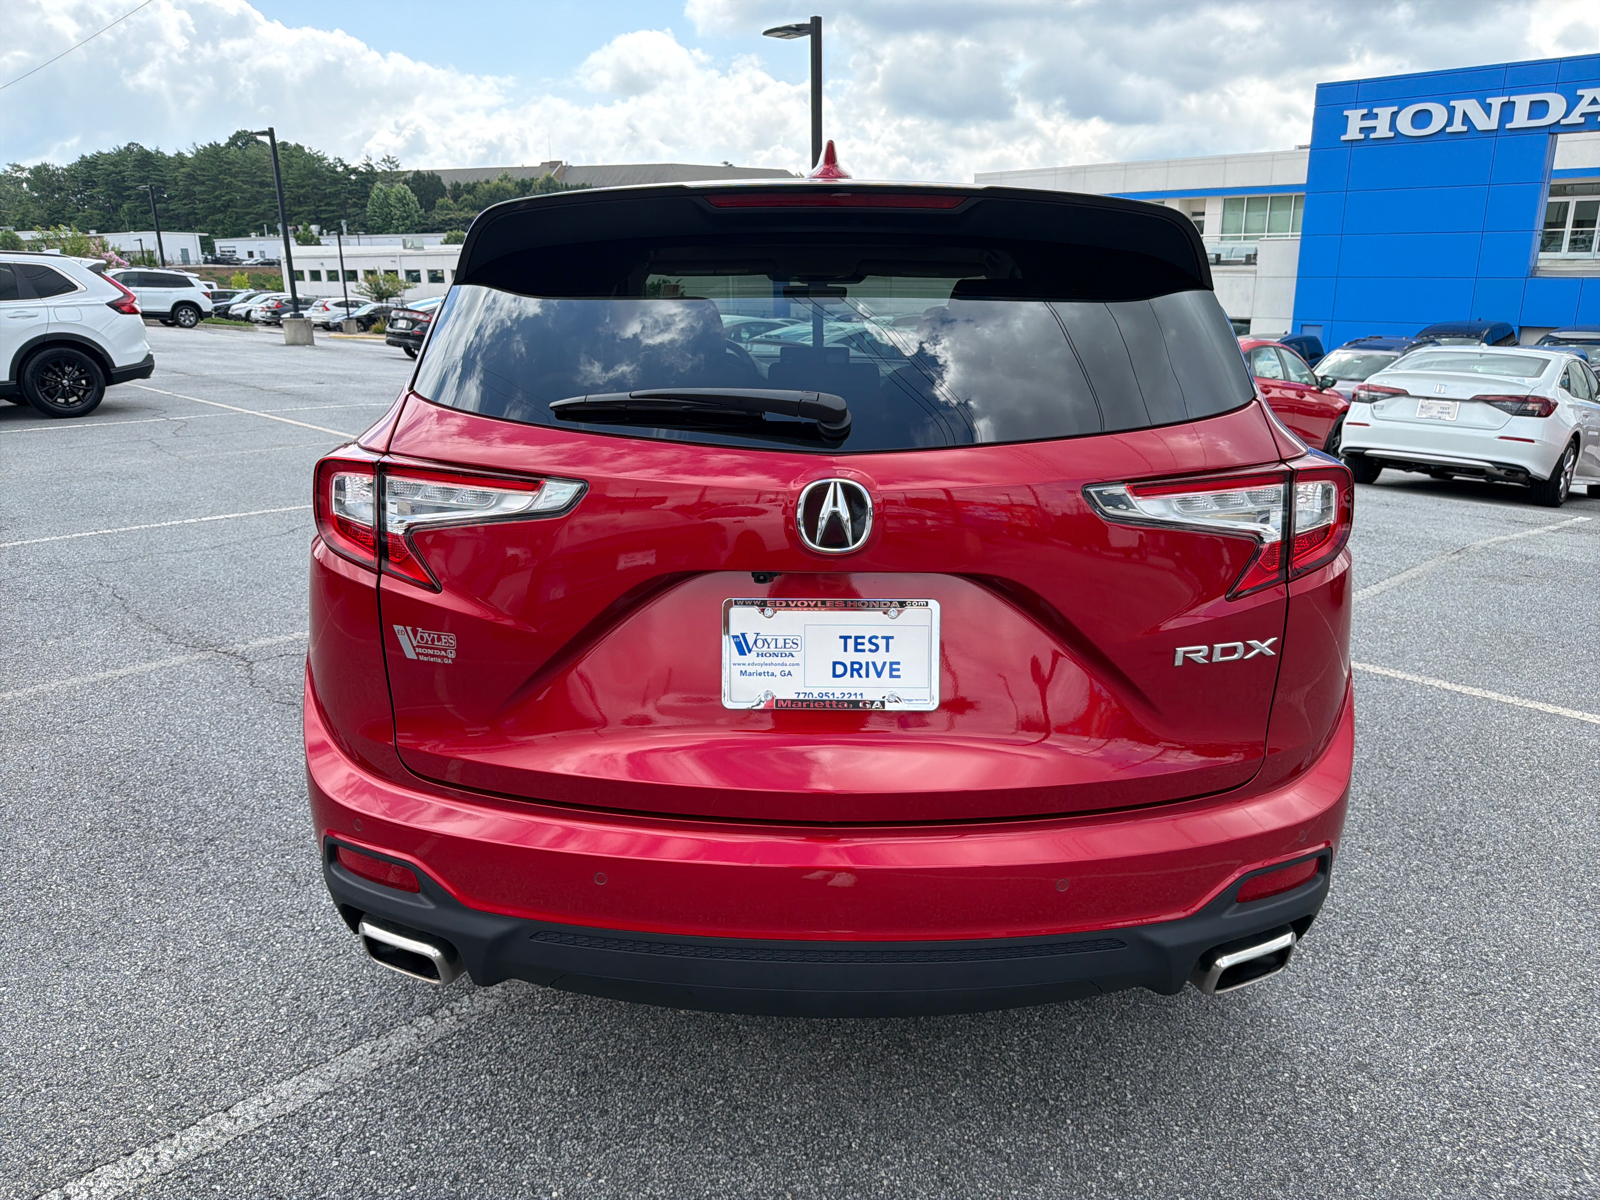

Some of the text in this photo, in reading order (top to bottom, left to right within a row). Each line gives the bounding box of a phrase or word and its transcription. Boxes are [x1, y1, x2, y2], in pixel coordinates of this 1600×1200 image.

[1340, 88, 1600, 141] HONDA
[406, 626, 455, 647] VOYLES
[740, 632, 799, 654] VOYLES
[838, 635, 895, 653] TEST
[415, 647, 447, 656] HONDA
[1173, 637, 1279, 667] RDX
[739, 670, 777, 678] Marietta,
[832, 661, 901, 679] DRIVE
[777, 700, 883, 709] Marietta, GA
